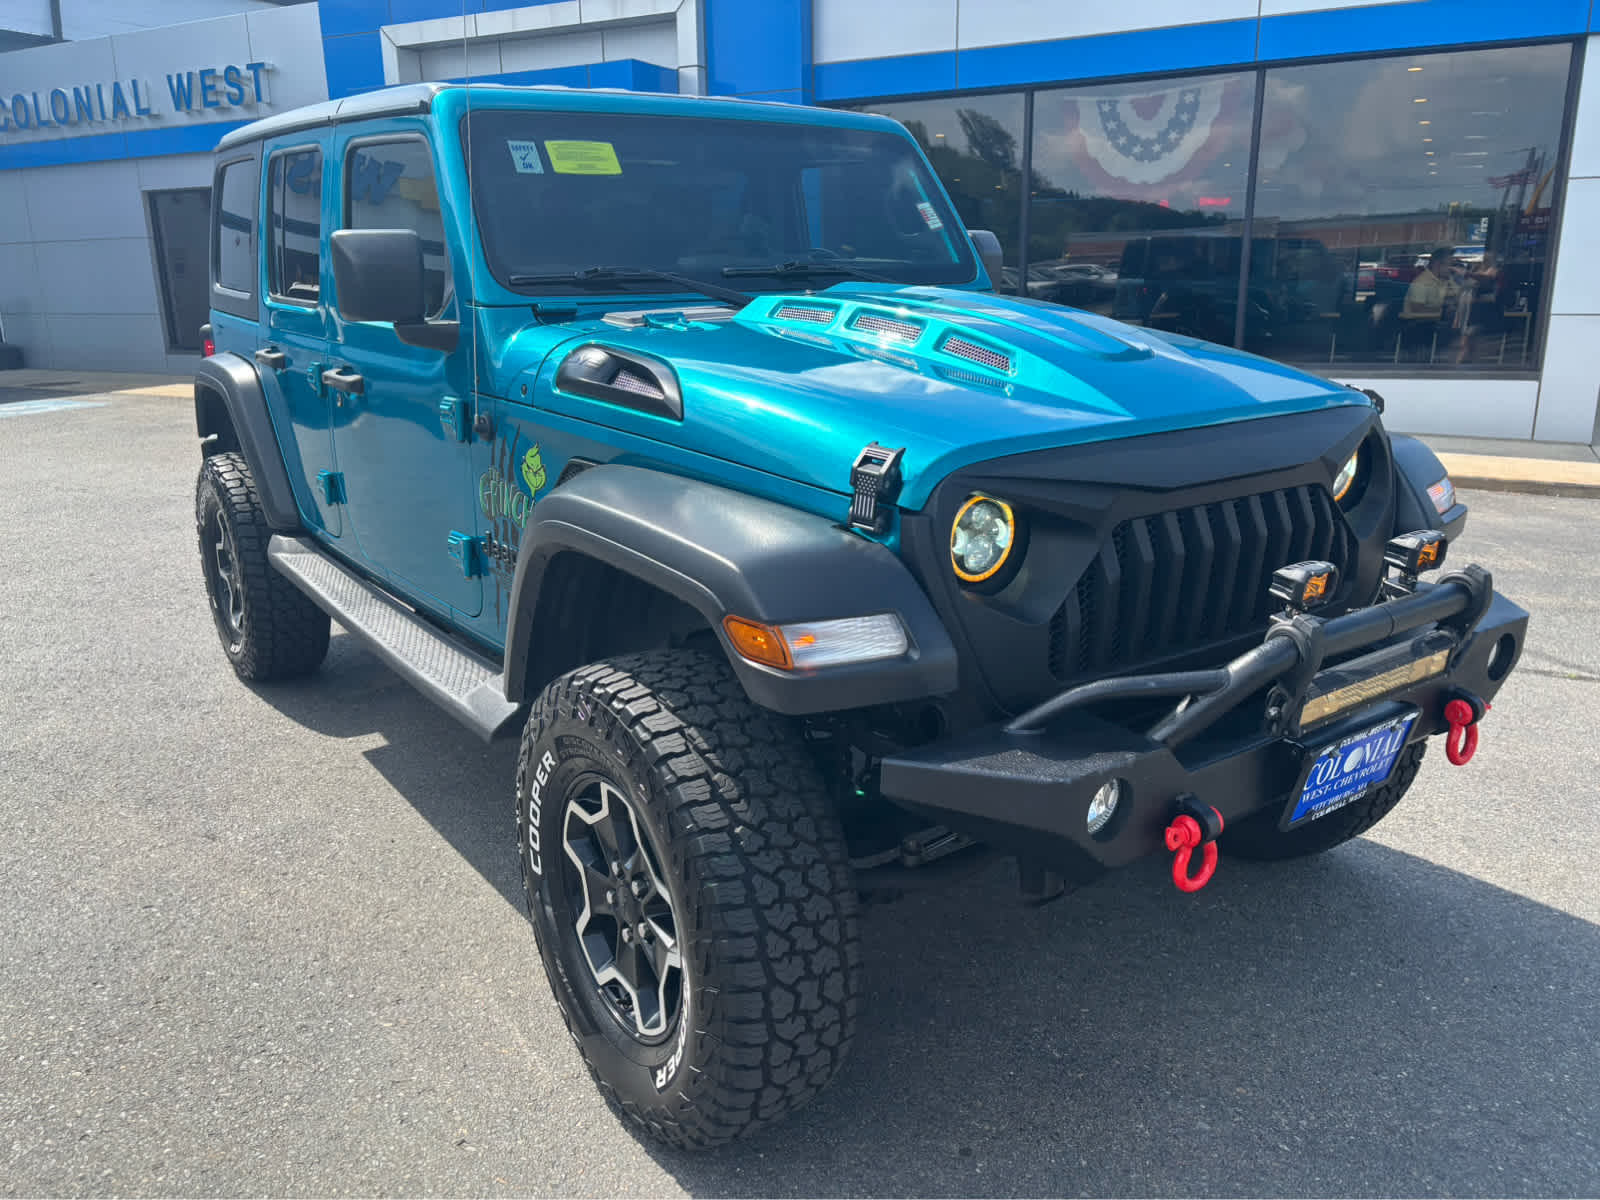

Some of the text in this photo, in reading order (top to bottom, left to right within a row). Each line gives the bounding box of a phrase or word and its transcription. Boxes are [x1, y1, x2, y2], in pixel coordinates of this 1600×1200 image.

[166, 61, 267, 113] WEST
[1303, 727, 1405, 791] COLONIAL
[529, 750, 558, 875] COOPER
